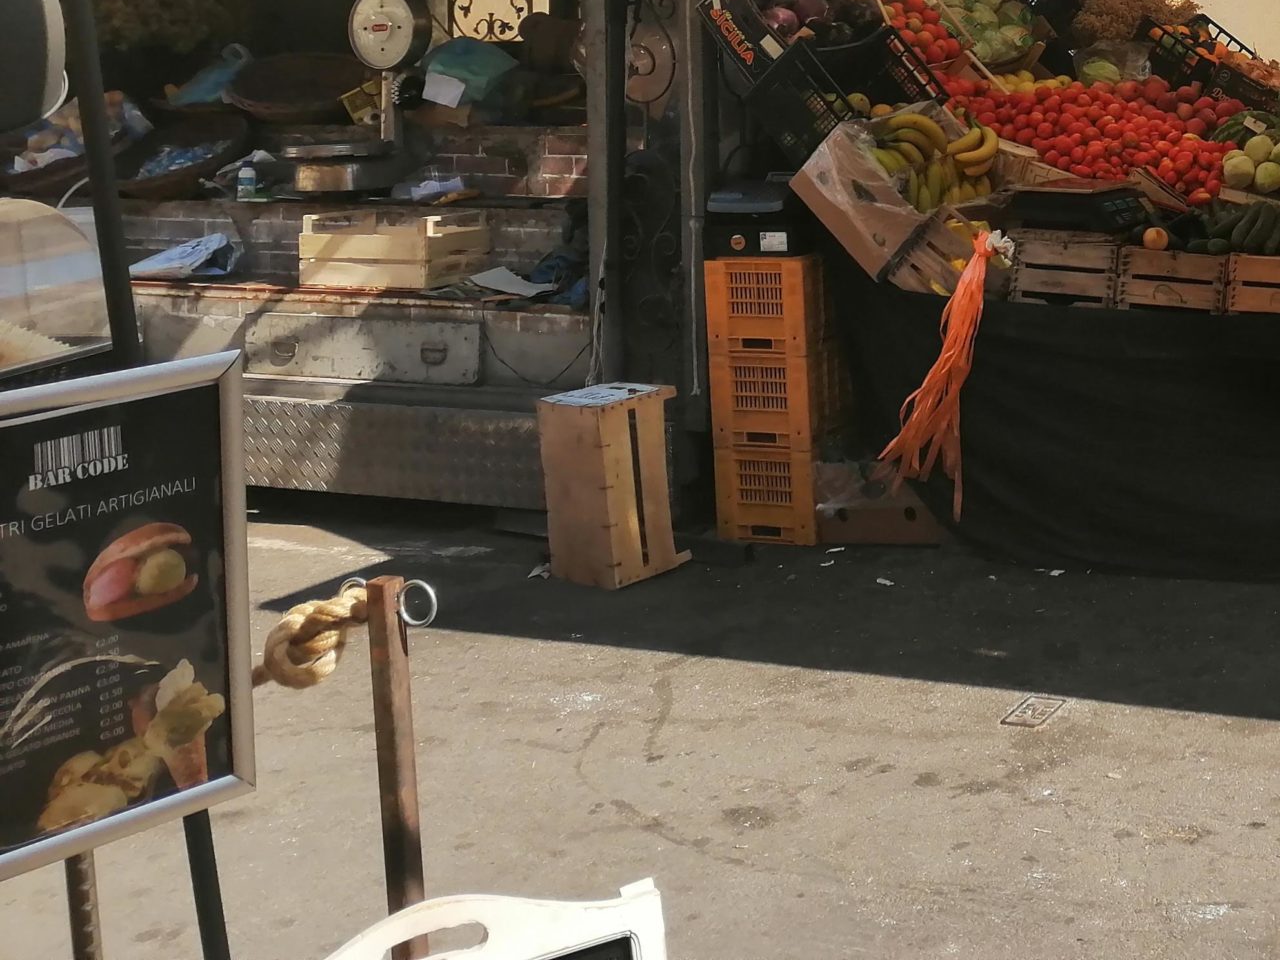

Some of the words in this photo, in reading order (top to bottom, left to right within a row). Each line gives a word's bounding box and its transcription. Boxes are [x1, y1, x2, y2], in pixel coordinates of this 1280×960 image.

[28, 466, 72, 491] BAR
[76, 453, 129, 480] CODE
[31, 503, 91, 531] GELATI
[96, 476, 197, 517] ARTIGIANALI
